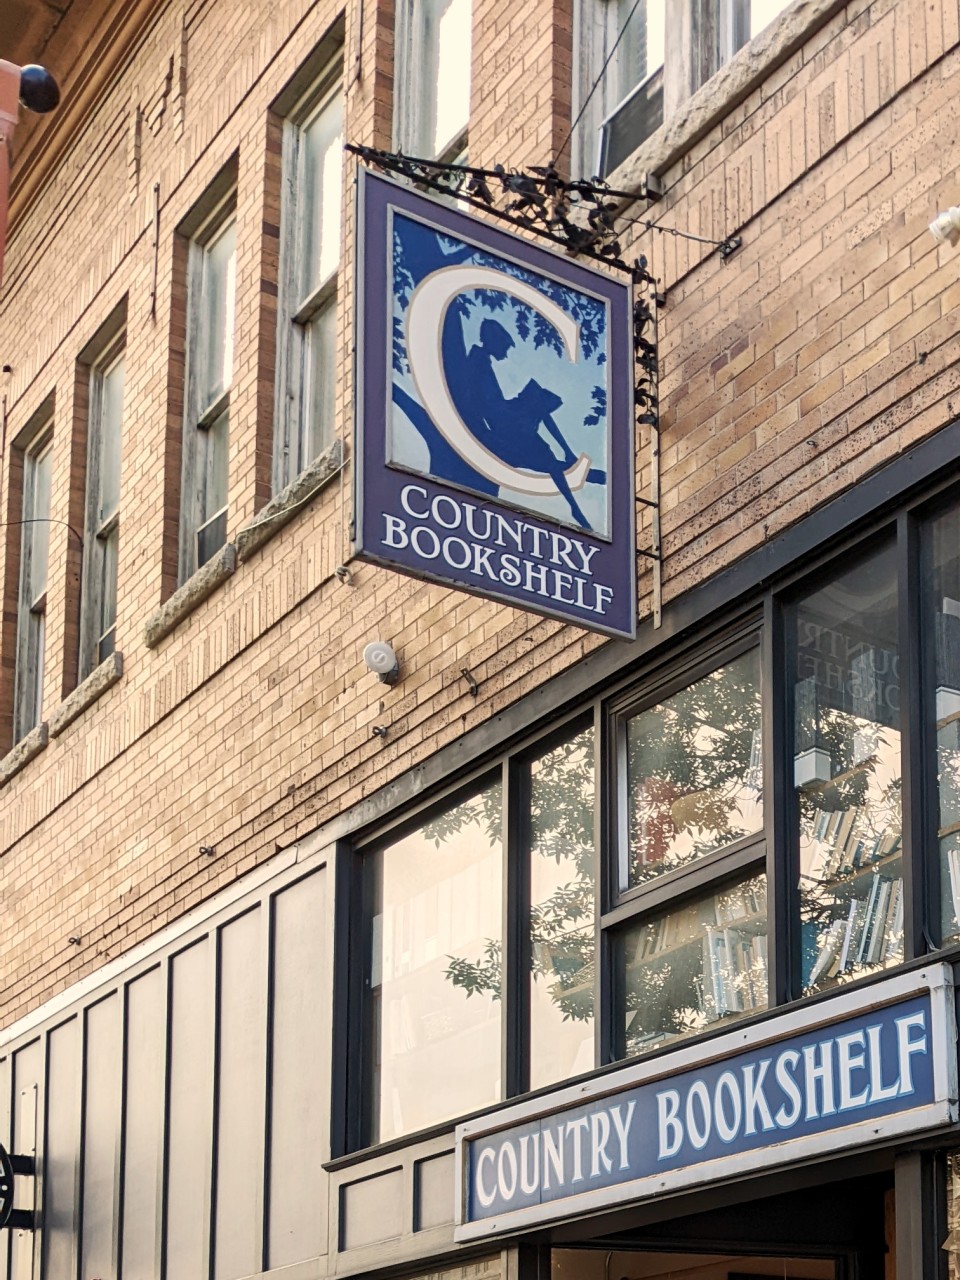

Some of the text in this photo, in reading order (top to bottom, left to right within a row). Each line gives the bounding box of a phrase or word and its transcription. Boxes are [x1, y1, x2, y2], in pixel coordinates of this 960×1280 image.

[381, 513, 614, 615] BOOKSHELF
[401, 485, 600, 575] COUNTRY
[475, 1011, 927, 1208] COUNTRY BOOKSHELF
